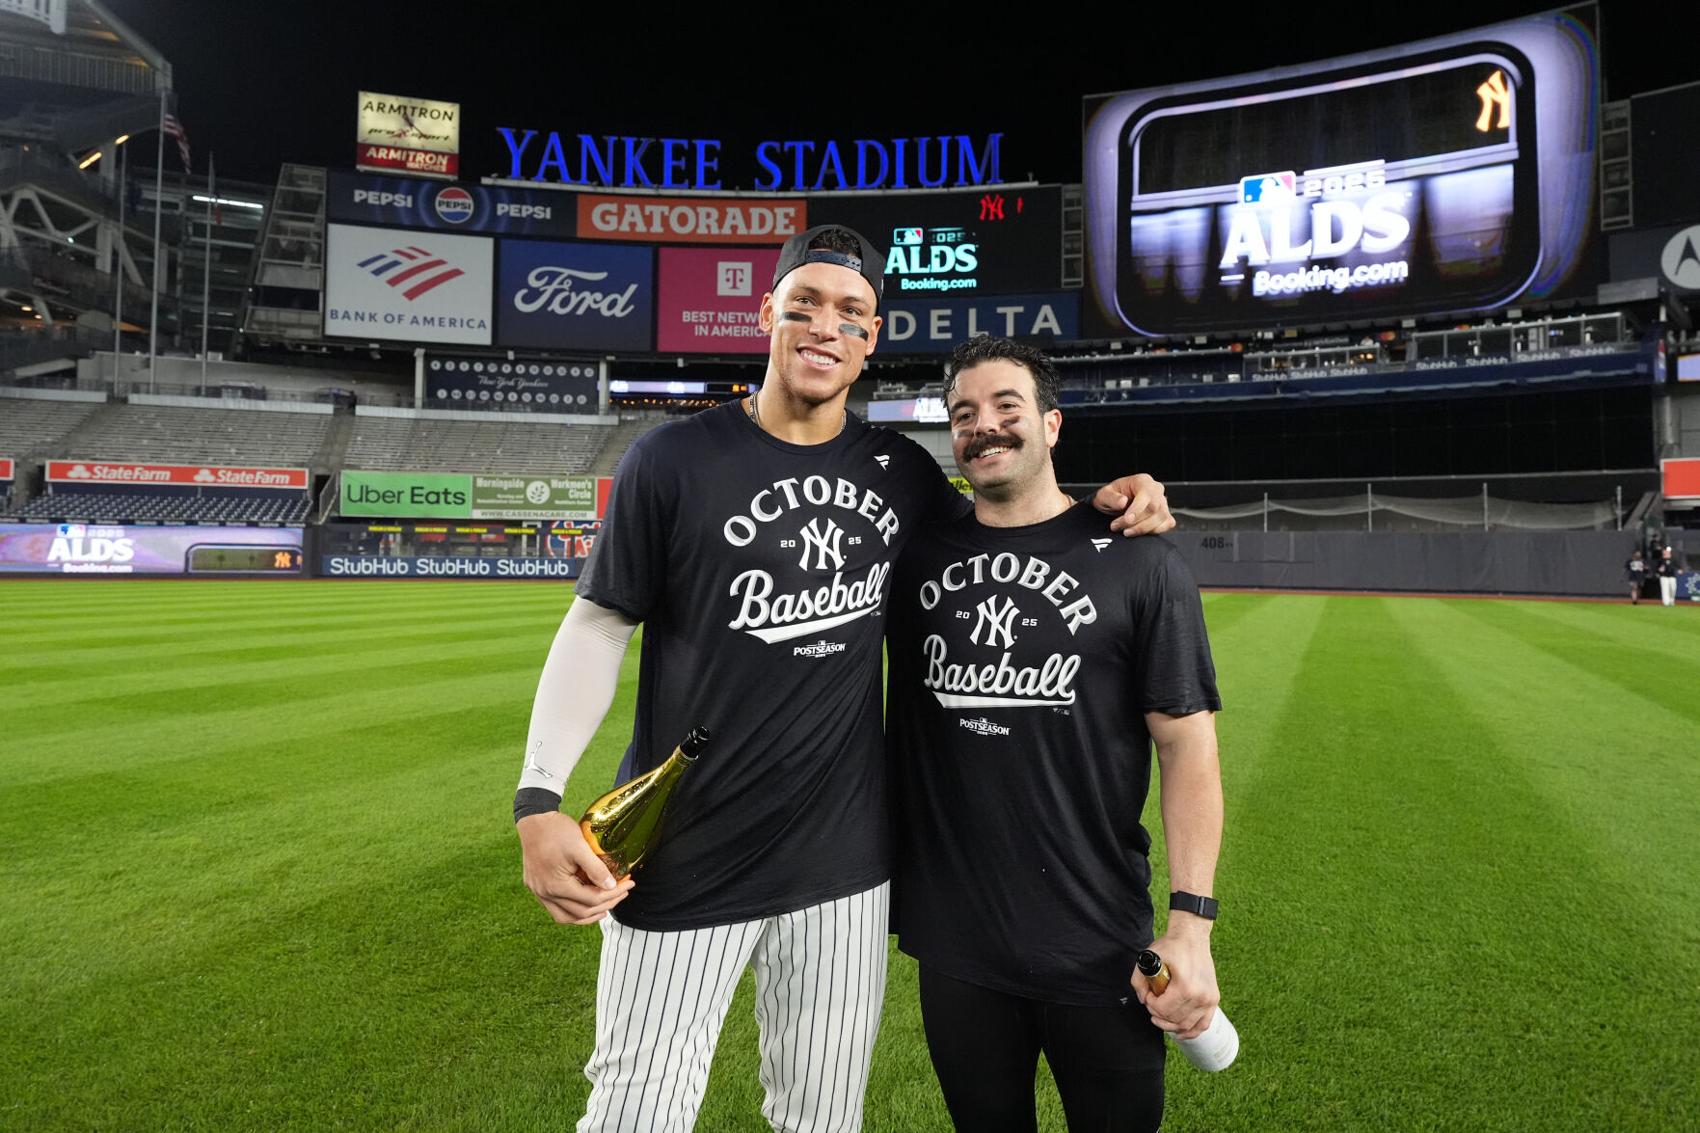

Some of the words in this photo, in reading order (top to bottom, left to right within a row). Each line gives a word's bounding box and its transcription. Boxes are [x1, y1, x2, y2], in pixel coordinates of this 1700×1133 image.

[363, 101, 454, 121] ARMITRON
[366, 147, 448, 165] ARMITRON
[496, 127, 722, 190] YANKEE
[754, 133, 1004, 190] STADIUM
[354, 189, 412, 208] PEPSI
[438, 199, 472, 211] PEPSI
[497, 203, 551, 219] PEPSI
[591, 203, 796, 235] GATORADE
[1219, 192, 1410, 268] ALDS
[884, 243, 978, 274] ALDS
[901, 277, 977, 291] Booking.com
[1254, 261, 1409, 295] Booking.com
[514, 265, 639, 318] Ford
[329, 309, 378, 323] BANK
[384, 312, 406, 325] OF
[410, 315, 488, 330] AMERICA
[682, 310, 715, 323] BEST
[717, 312, 761, 324] NETW
[888, 304, 1063, 341] DELTA
[694, 325, 709, 336] IN
[346, 484, 403, 504] Uber
[410, 485, 466, 506] Eats
[724, 475, 899, 547] OCTOBER
[47, 537, 135, 562] ALDS
[780, 540, 796, 548] 20
[798, 517, 846, 572] NY
[848, 537, 862, 545] 25
[1201, 536, 1225, 549] 408
[330, 557, 409, 575] StubHub
[416, 557, 490, 576] StubHub
[496, 558, 569, 576] StubHub
[728, 561, 890, 631] Baseball
[920, 552, 1098, 636] OCTOBER
[955, 610, 970, 620] 20
[969, 594, 1021, 650] NY
[1022, 618, 1038, 627] 25
[793, 643, 846, 657] POSTSEASON
[923, 634, 1081, 699] Baseball
[959, 718, 1010, 736] POSTSEASON
